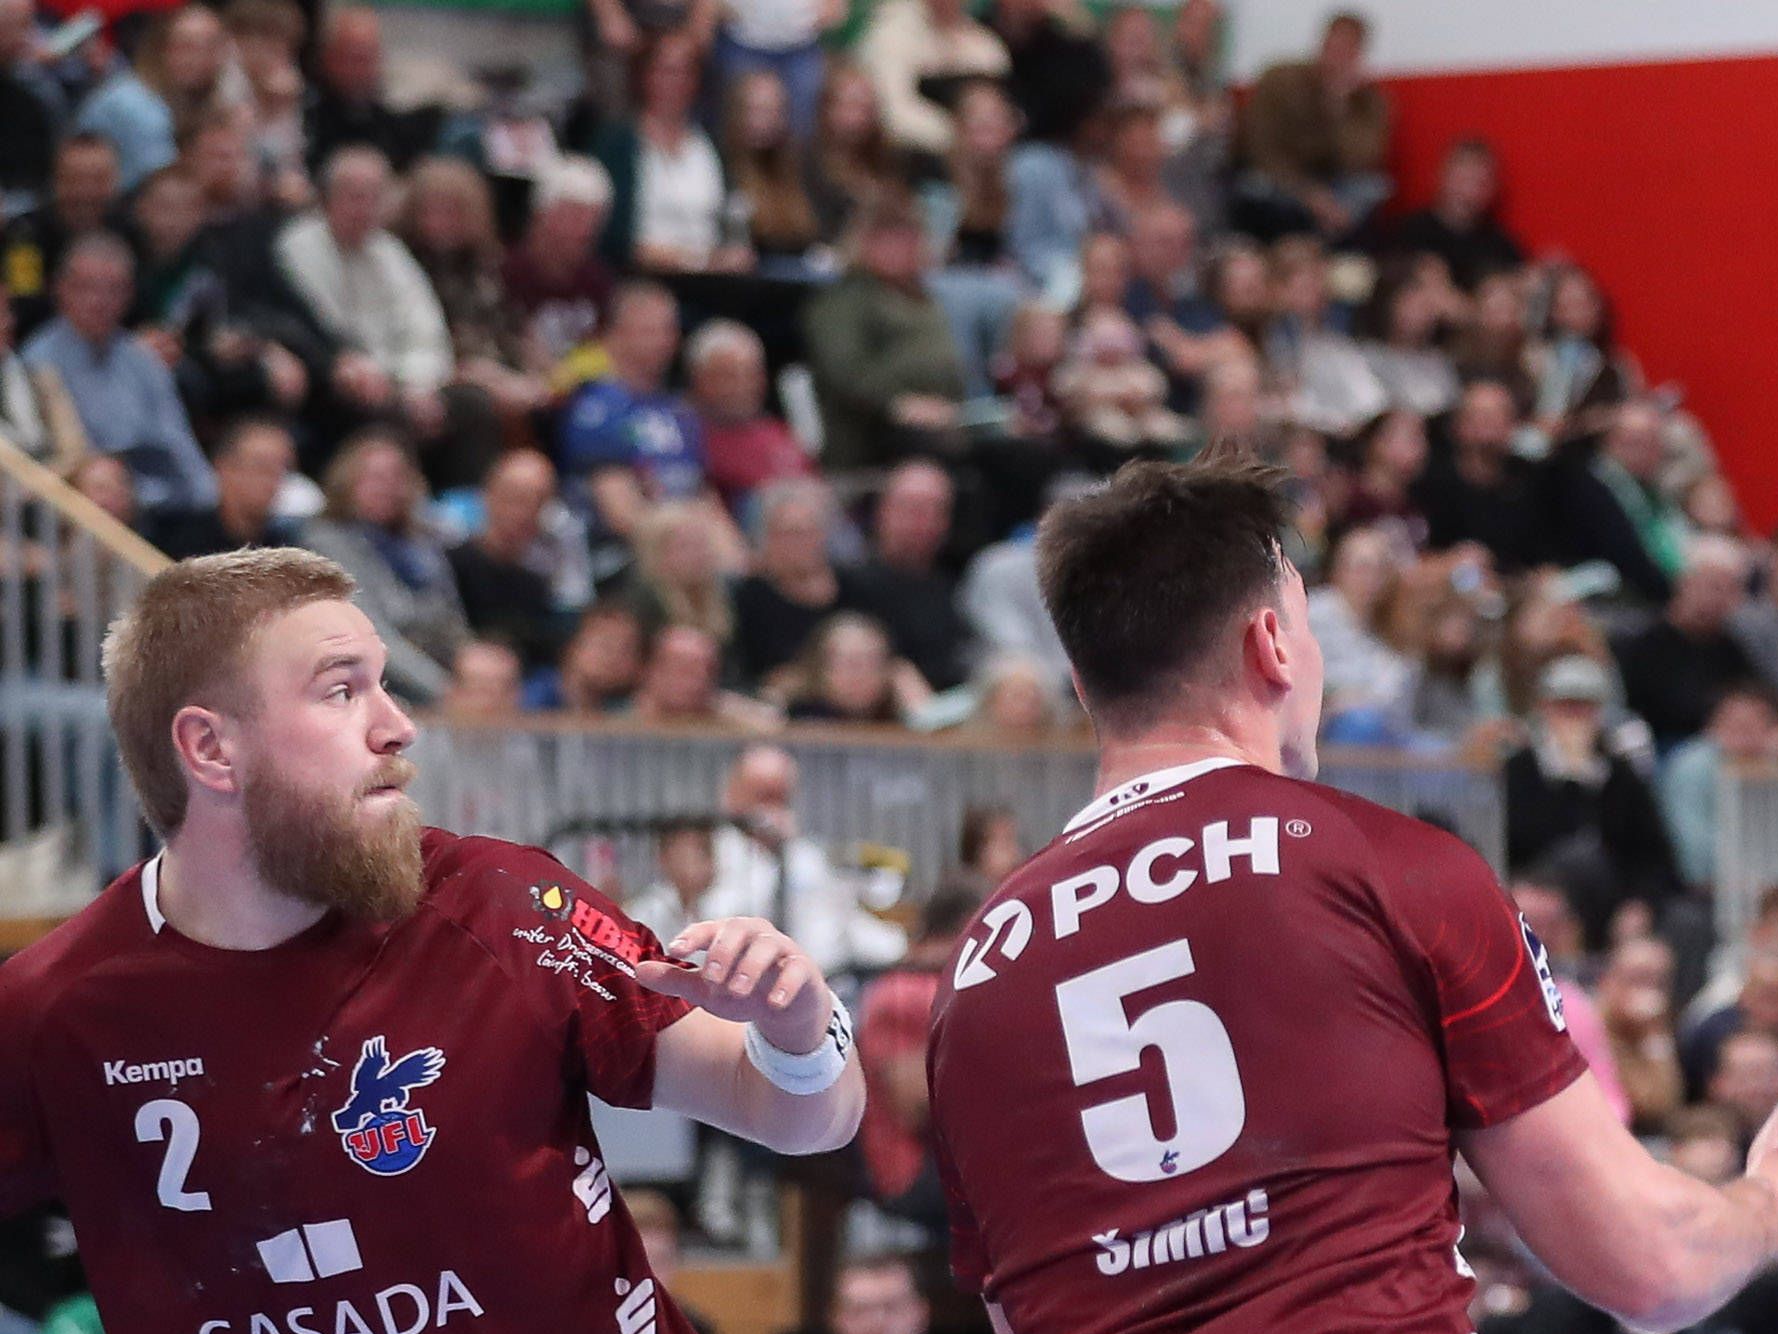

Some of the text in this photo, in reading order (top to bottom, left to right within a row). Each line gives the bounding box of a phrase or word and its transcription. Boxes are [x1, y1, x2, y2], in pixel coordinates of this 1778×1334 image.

[103, 1058, 204, 1087] Kempa
[1055, 938, 1247, 1182] 5
[134, 1099, 212, 1211] 2
